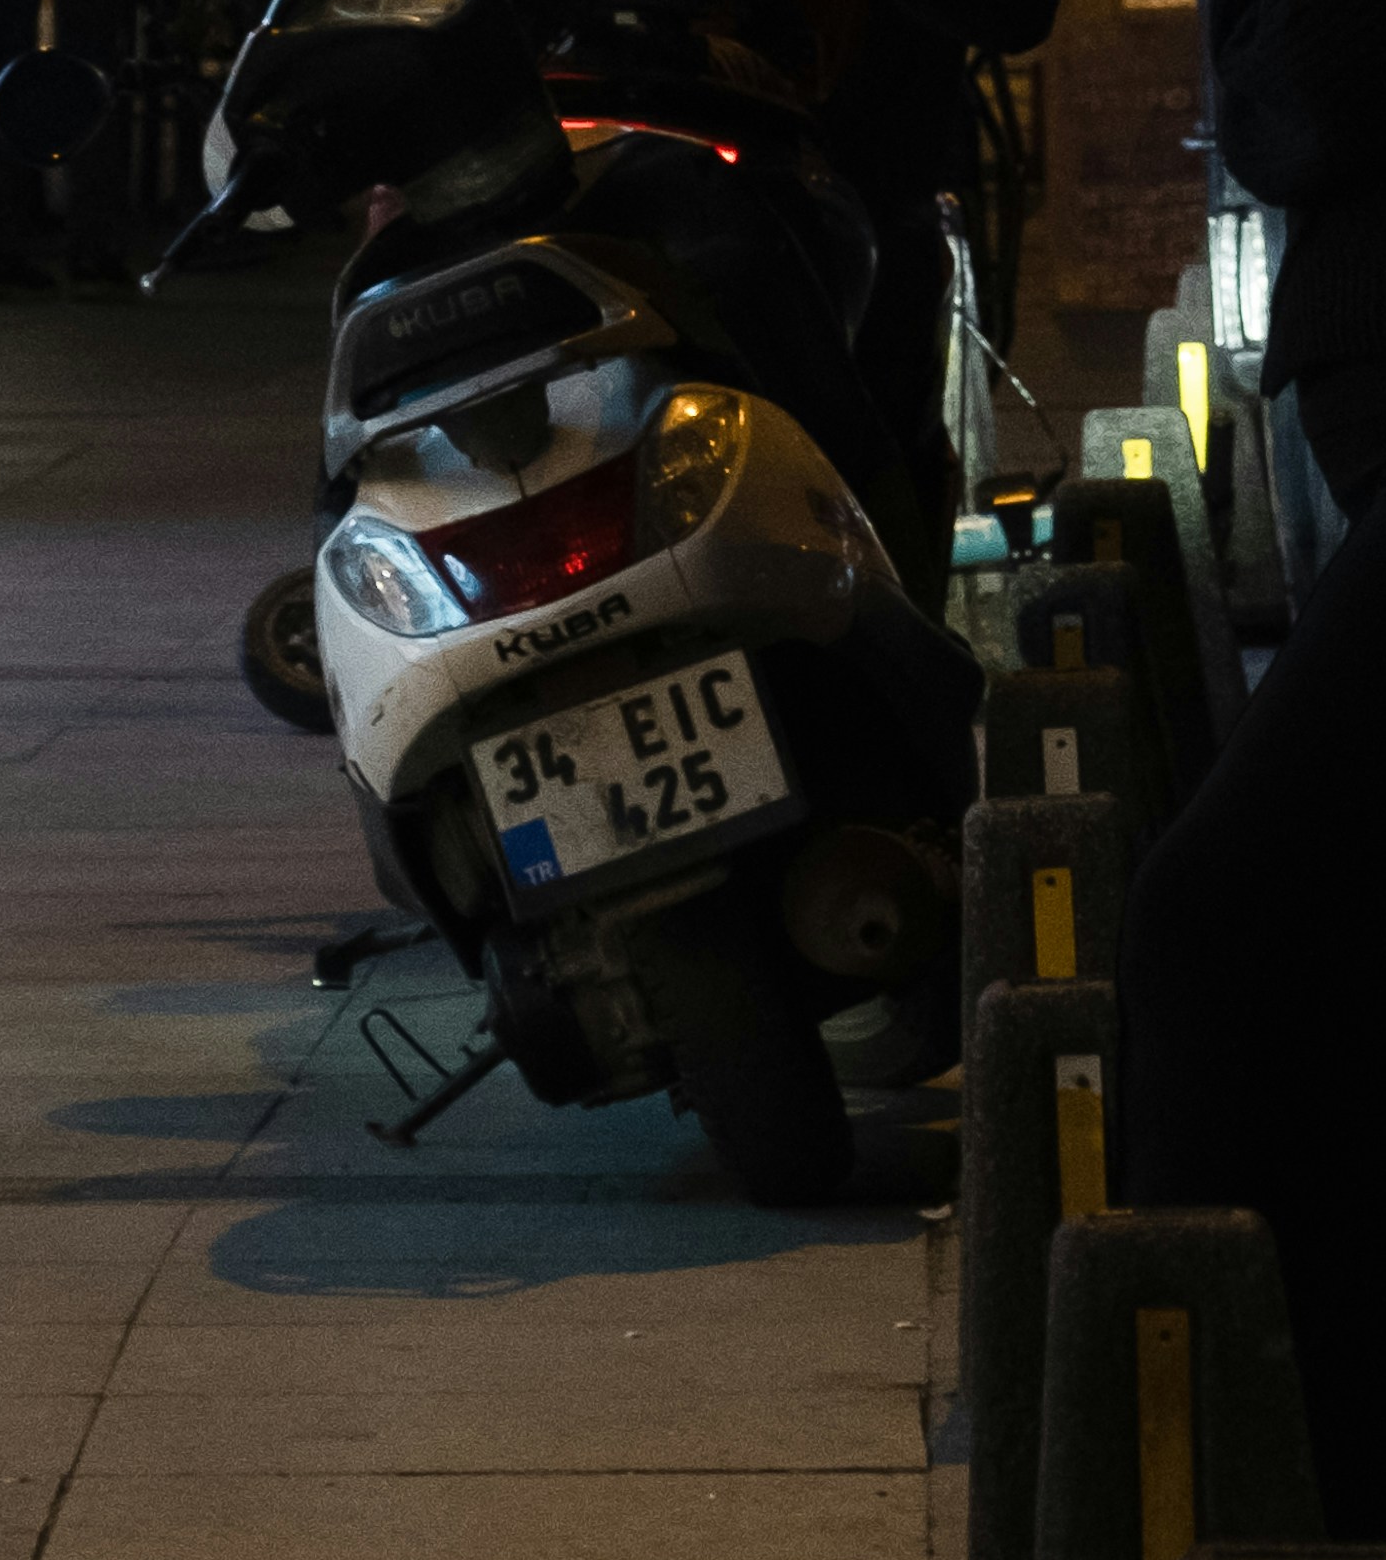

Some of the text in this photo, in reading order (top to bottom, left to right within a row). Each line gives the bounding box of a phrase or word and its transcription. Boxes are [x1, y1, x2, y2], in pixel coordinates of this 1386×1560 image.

[398, 274, 527, 338] KUBA
[493, 591, 632, 663] KUBA
[493, 668, 744, 805] 34 EIC
[607, 750, 729, 842] 425
[522, 860, 556, 887] TR
